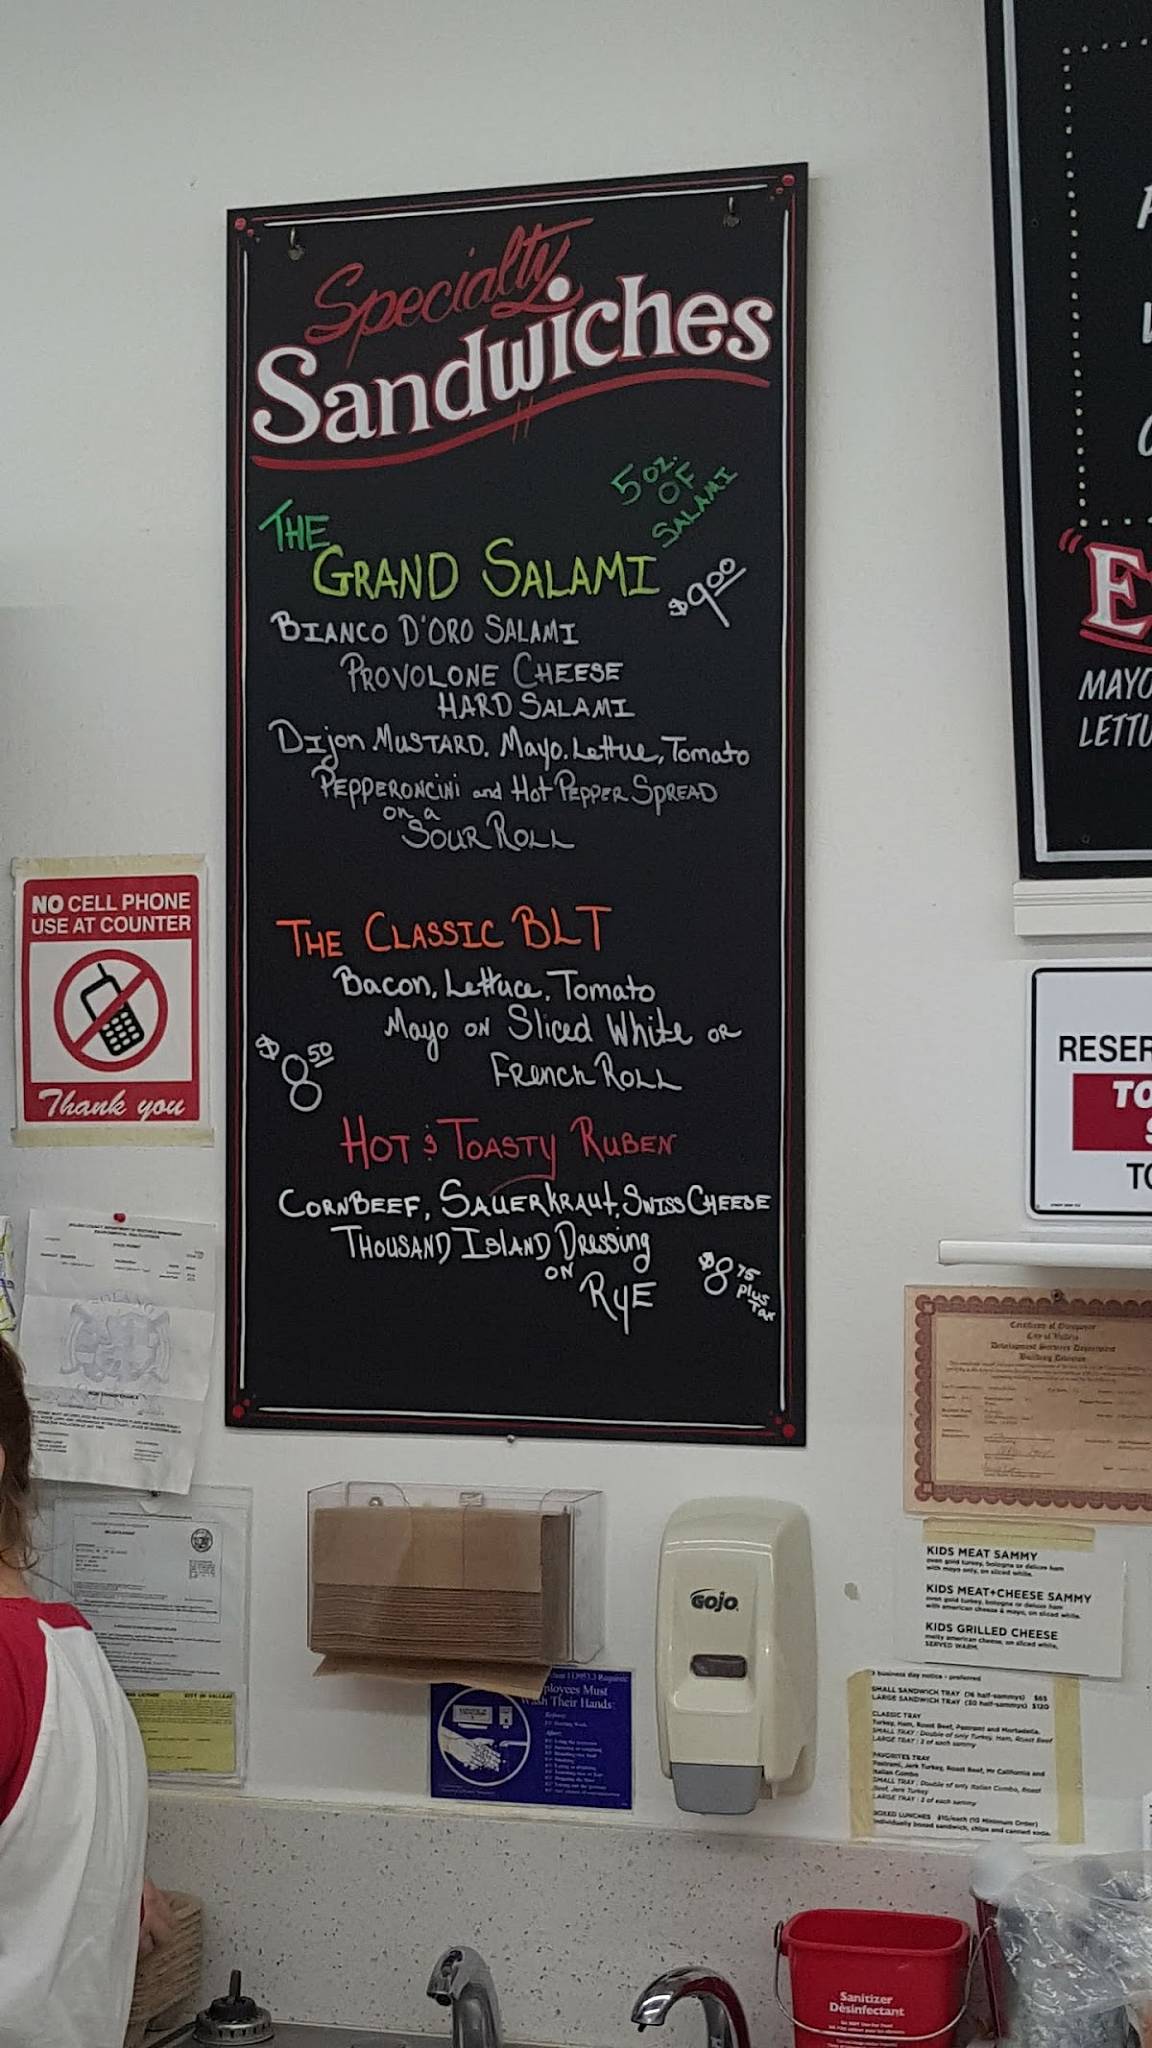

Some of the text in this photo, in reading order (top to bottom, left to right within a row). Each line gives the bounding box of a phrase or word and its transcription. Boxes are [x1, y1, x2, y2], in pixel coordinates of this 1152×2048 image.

[305, 218, 594, 368] Specialty
[251, 272, 776, 445] Sandwiches
[611, 463, 641, 505] 5
[658, 461, 694, 504] OF
[651, 466, 738, 548] SALAMI
[259, 499, 330, 551] THE
[313, 538, 660, 600] GRAND SALAMI
[270, 611, 579, 646] BIANCO D'ORO SALAMI
[340, 652, 623, 692] PROVOLONE CHEESE
[438, 692, 635, 719] HARD SALAMI
[661, 736, 749, 765] Tomato
[473, 781, 501, 801] and
[511, 773, 554, 803] Hot
[552, 769, 629, 809] PEPPER
[631, 775, 719, 816] SPREAD
[401, 810, 575, 851] SOUR ROLL
[424, 807, 440, 820] a
[32, 892, 191, 915] NO CELL PHONE
[31, 915, 191, 935] USE AT COUNTER
[276, 905, 611, 958] THE CLASSIC BLT
[546, 970, 655, 1002] Tomato
[384, 1007, 448, 1062] Mayo
[508, 1004, 593, 1043] Sliced
[607, 1007, 693, 1047] White
[594, 1052, 682, 1091] ROLL
[38, 1088, 186, 1121] Thank you
[341, 1115, 409, 1169] HOT
[436, 1117, 556, 1192] TOASTY
[571, 1116, 676, 1161] RUBEN
[622, 1183, 686, 1216] SWISS
[687, 1185, 772, 1216] CHEESE
[330, 1225, 451, 1264] THOUSAND
[545, 1262, 573, 1280] ON
[926, 1545, 1038, 1561] KIDS MEAT SAMMY
[926, 1583, 954, 1594] KIDS
[1048, 1591, 1092, 1604] SAMMY
[925, 1622, 1058, 1640] KIDS GRILLED CHEESE
[550, 1695, 577, 1707] Their
[583, 1684, 608, 1697] Must
[840, 1991, 894, 2004] Sanitizer
